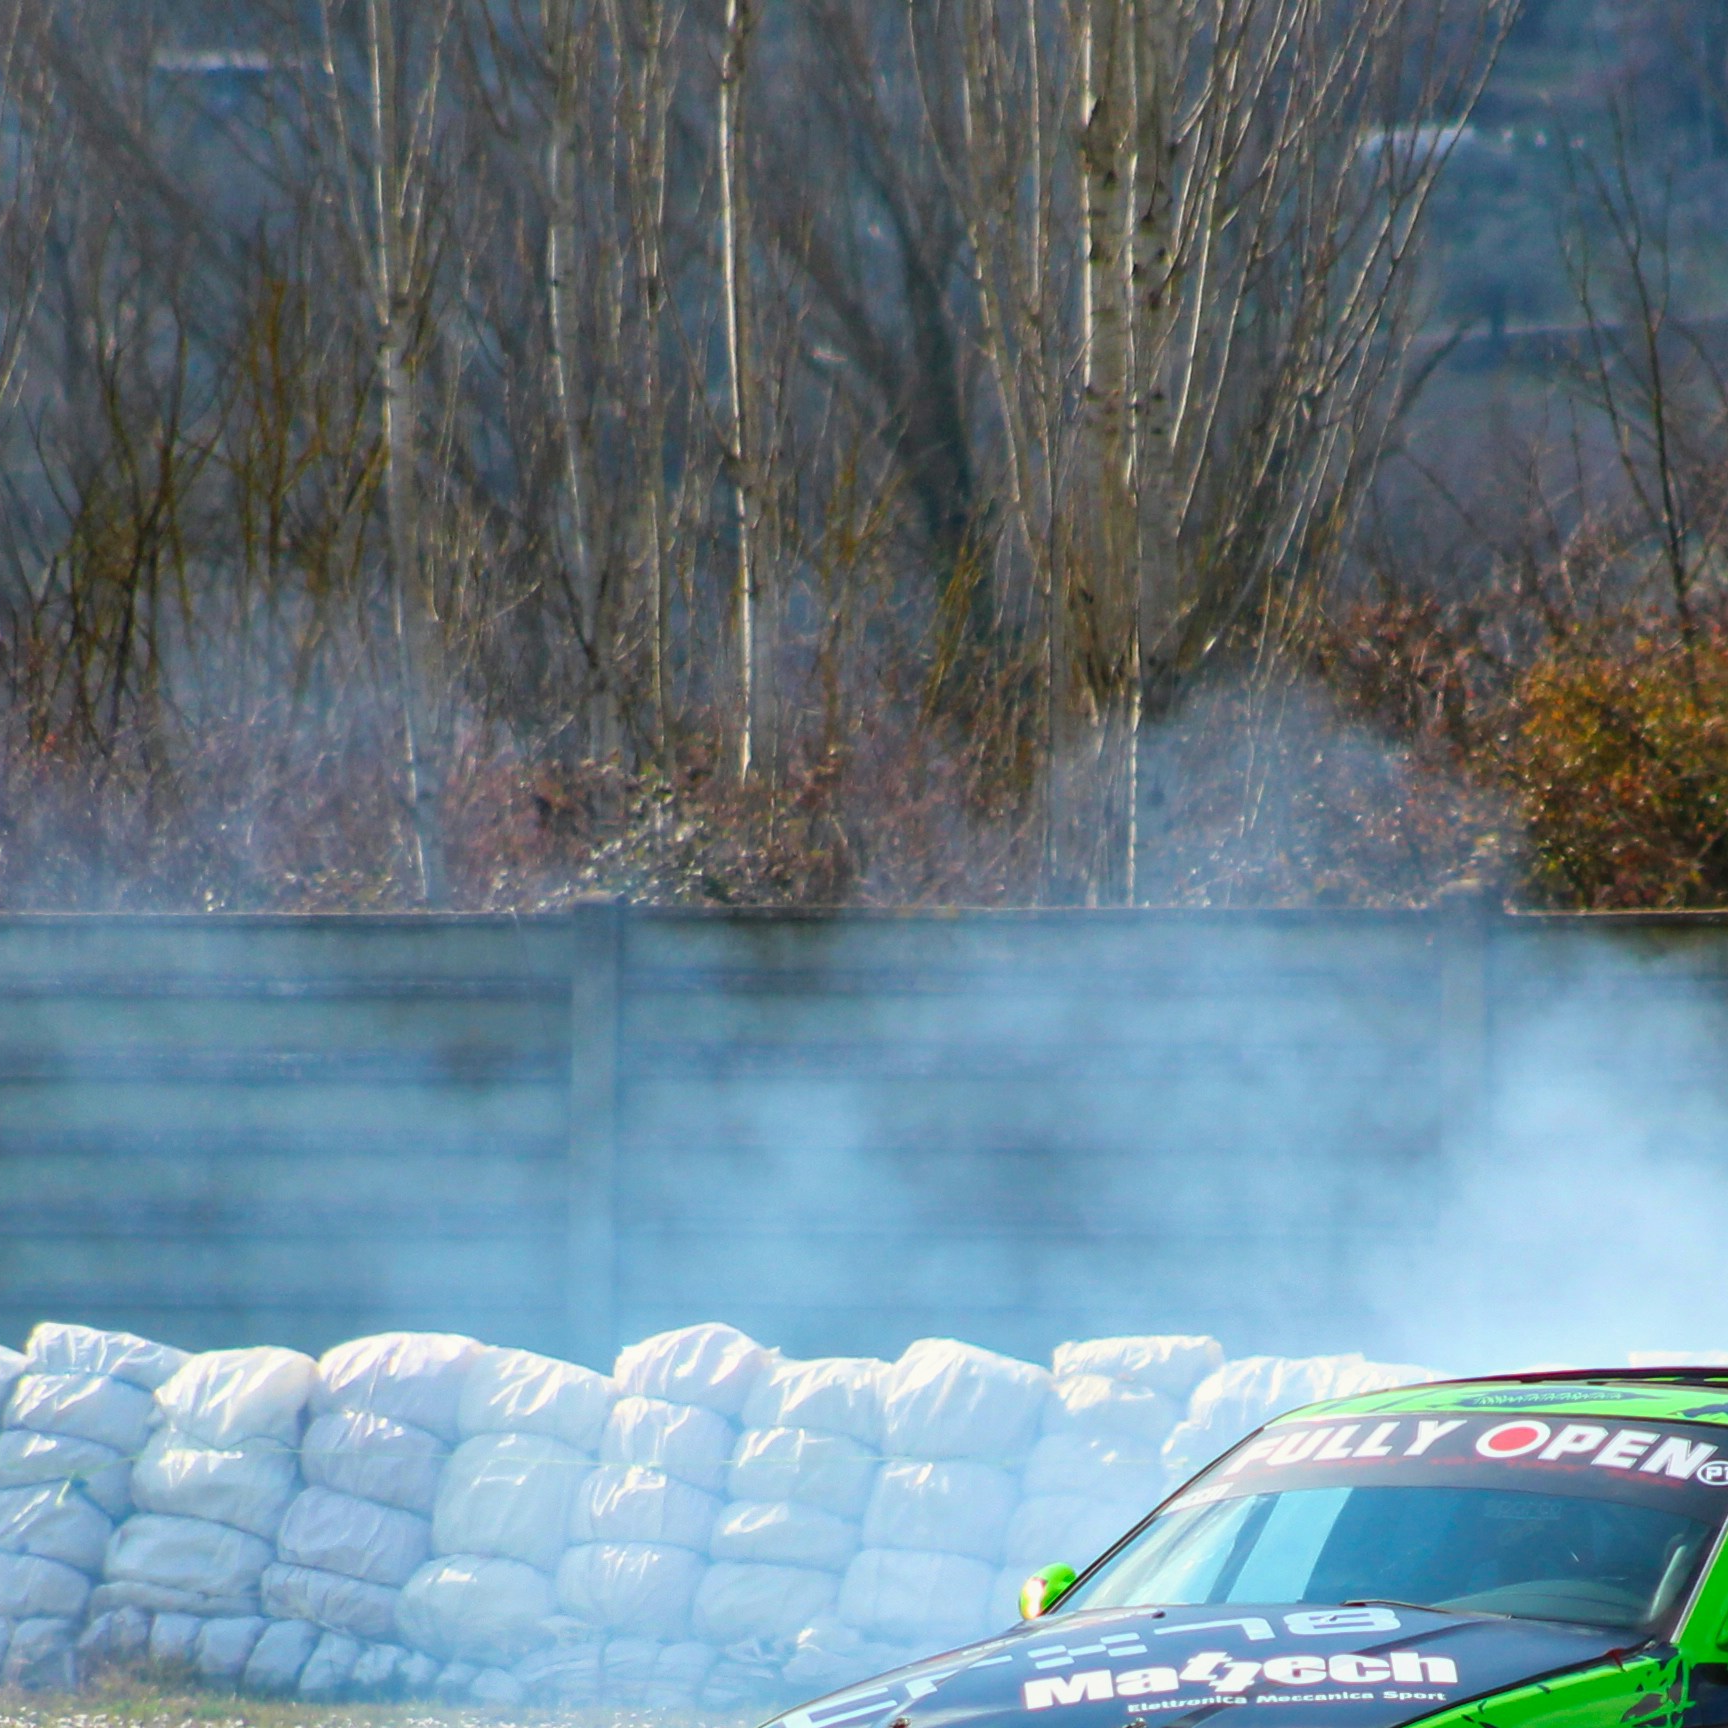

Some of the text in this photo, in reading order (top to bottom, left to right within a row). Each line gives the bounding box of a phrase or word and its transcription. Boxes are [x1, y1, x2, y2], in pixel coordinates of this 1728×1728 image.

[1223, 1419, 1719, 1480] FULLY OPEN
[1127, 1690, 1448, 1712] Elettronica Meccanica Sport
